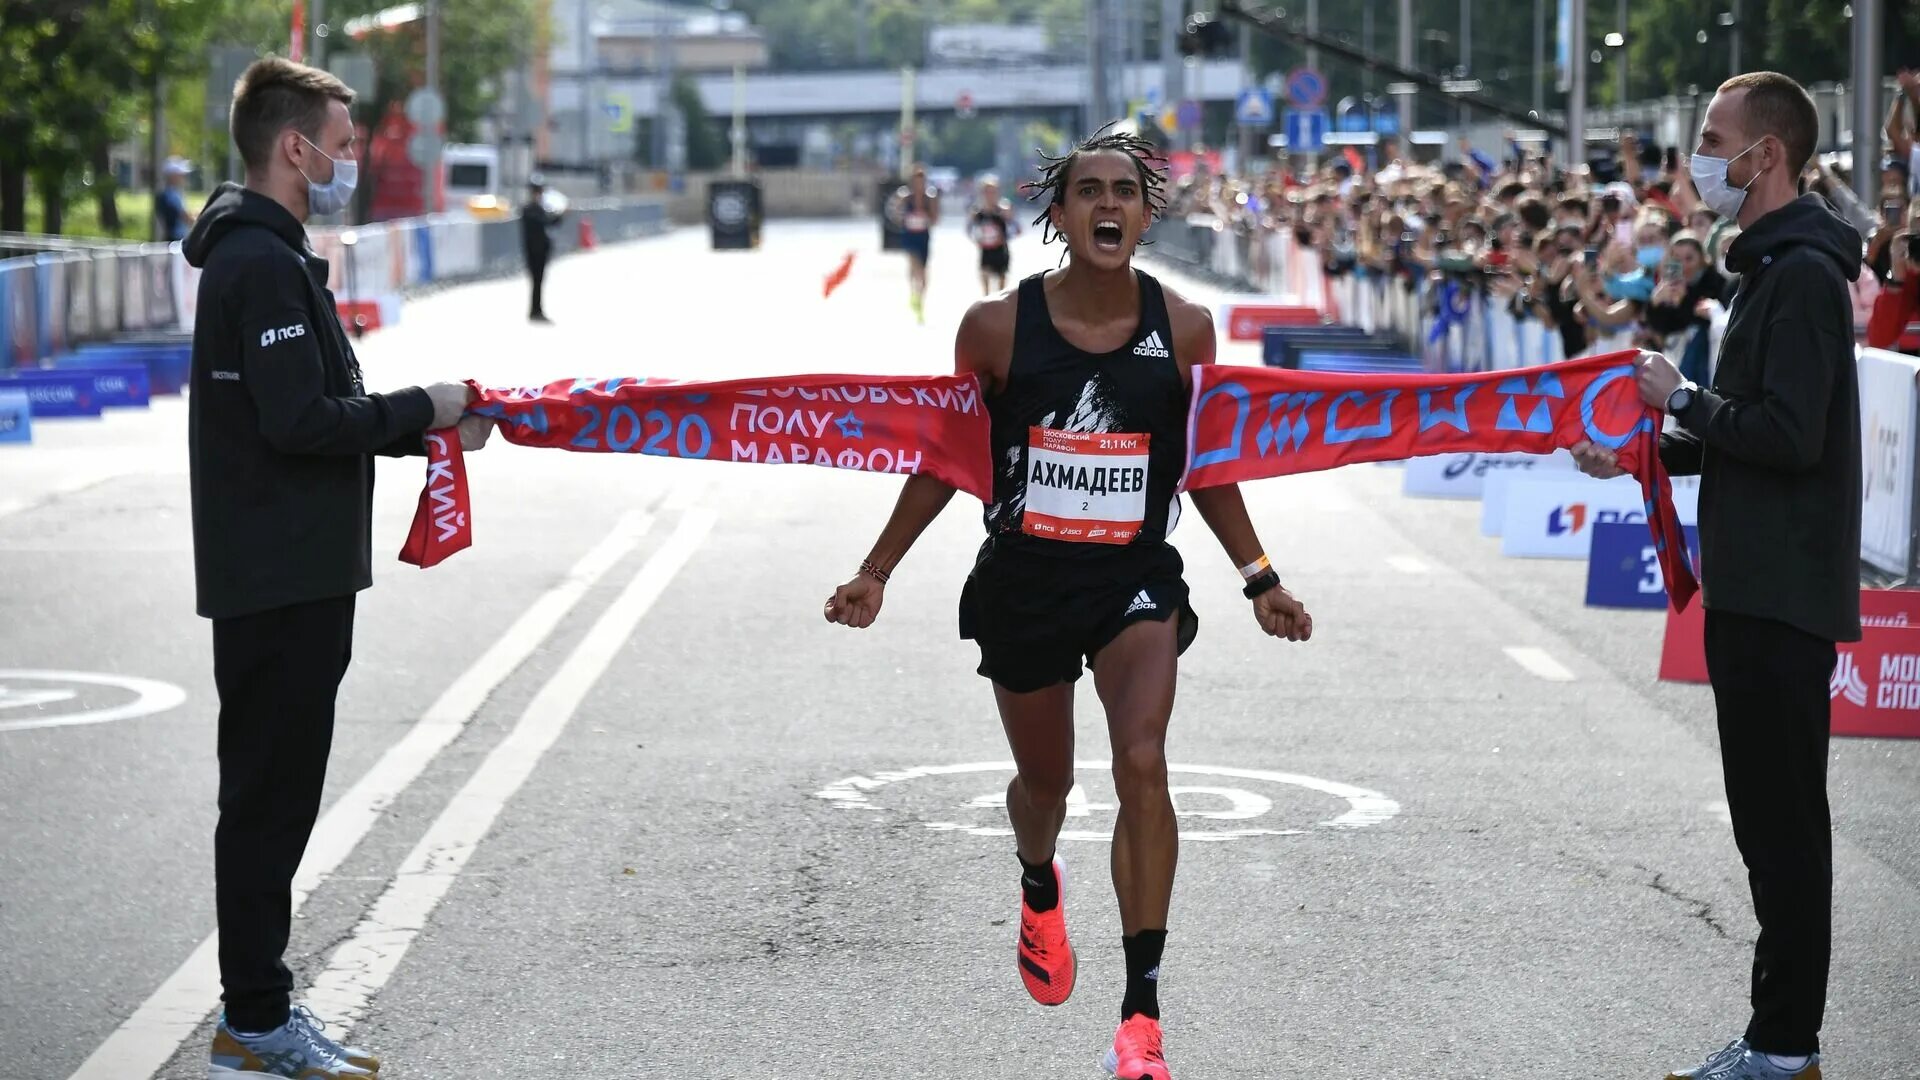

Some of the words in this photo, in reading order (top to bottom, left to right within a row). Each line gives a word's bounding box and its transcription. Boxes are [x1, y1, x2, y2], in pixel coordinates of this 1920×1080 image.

[277, 324, 305, 341] ПСБ
[1133, 346, 1169, 358] adidas
[735, 383, 979, 416] ОСКОВСКИЙ
[730, 403, 833, 438] ПОЛУ
[571, 405, 712, 459] 2020
[1043, 430, 1090, 442] МОСКОВСКИЙ
[1043, 442, 1076, 453] МАРАФОН
[1100, 440, 1118, 449] 21,1
[1120, 440, 1137, 449] КМ
[730, 440, 922, 475] МАРАФОН
[1030, 460, 1144, 496] АХМАДЕЕВ
[1082, 502, 1089, 511] 2
